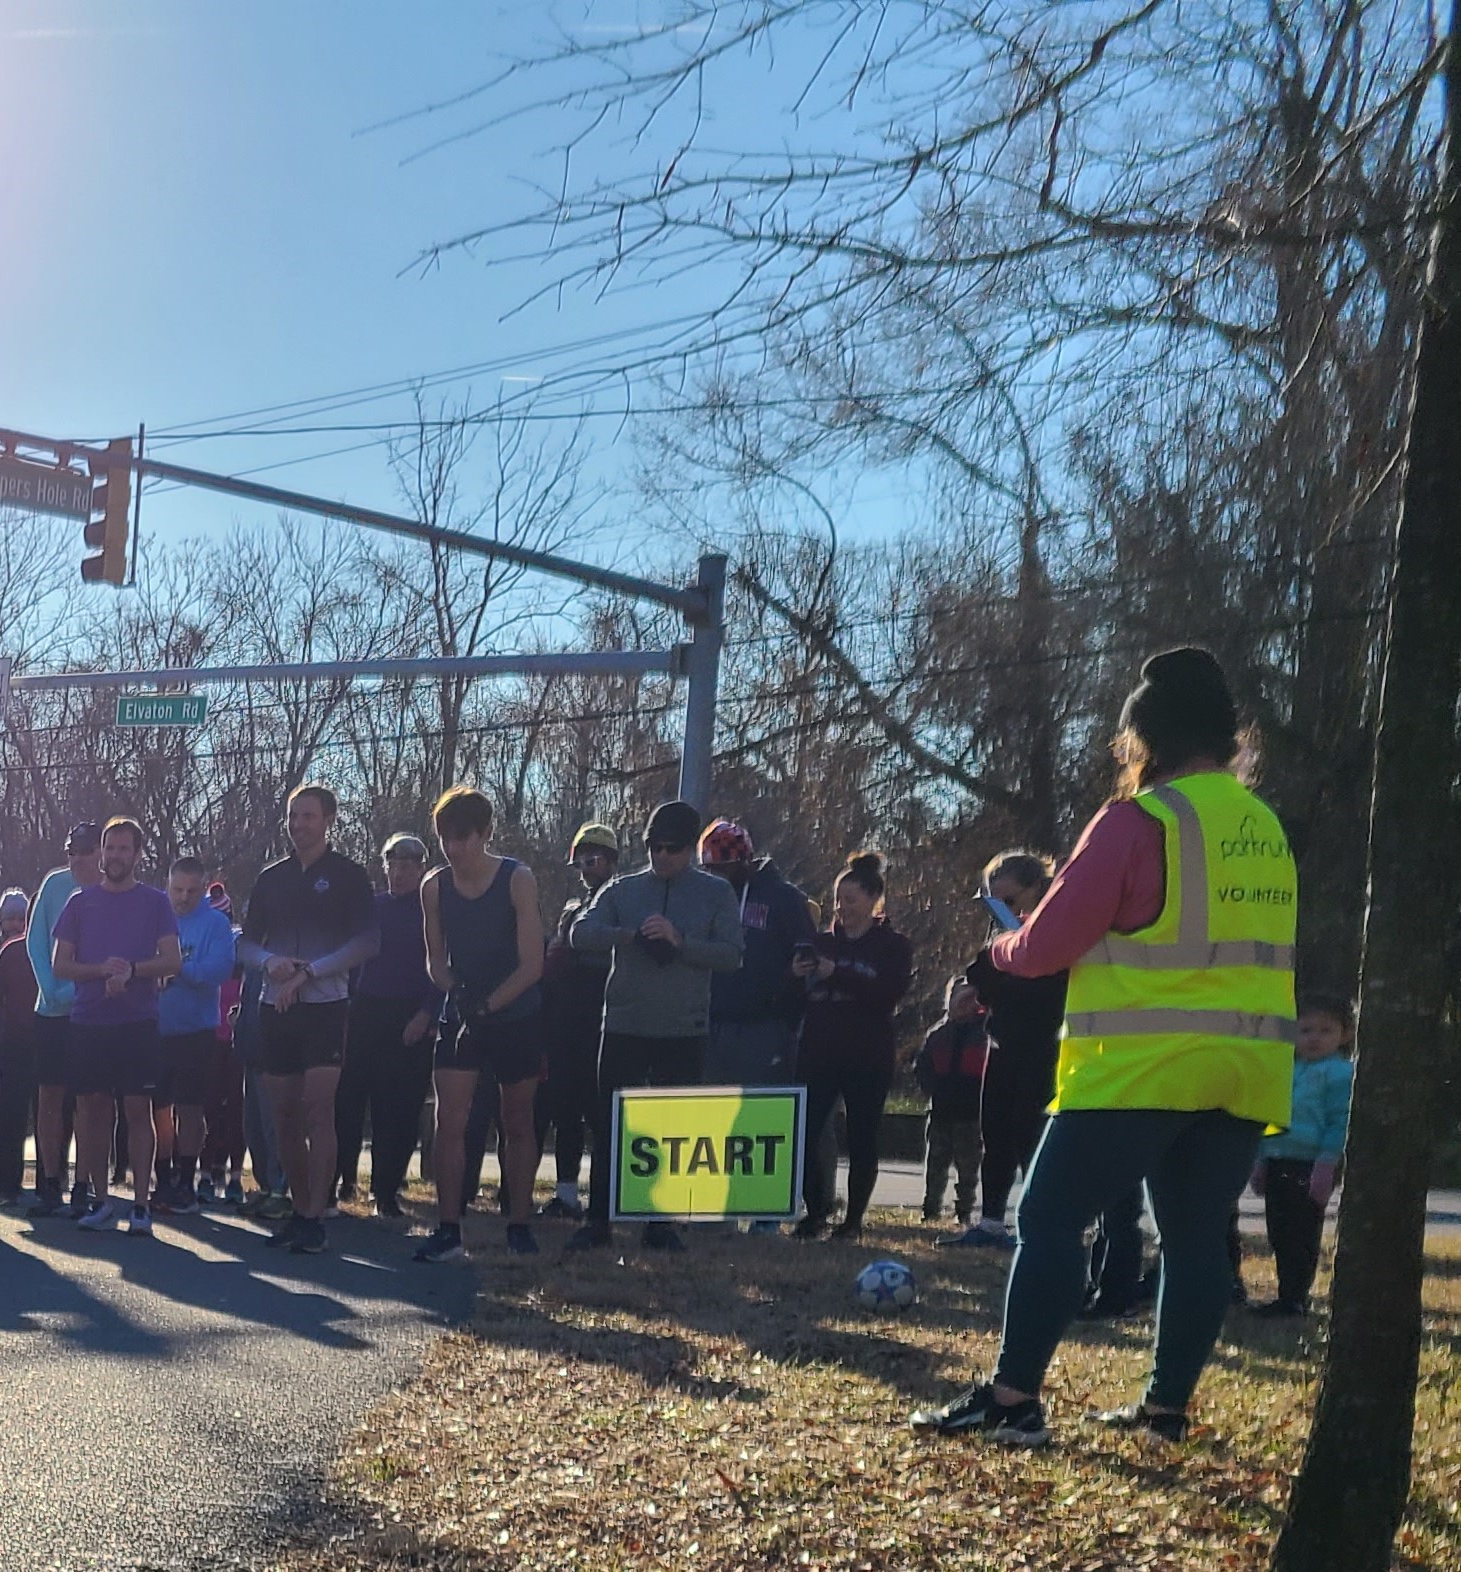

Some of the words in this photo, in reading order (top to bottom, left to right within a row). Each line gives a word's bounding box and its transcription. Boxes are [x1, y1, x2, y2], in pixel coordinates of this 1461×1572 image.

[38, 478, 67, 507] Hole
[72, 487, 90, 513] Rd
[125, 701, 173, 720] Elvaton
[182, 702, 199, 719] Rd
[630, 1135, 786, 1178] START
